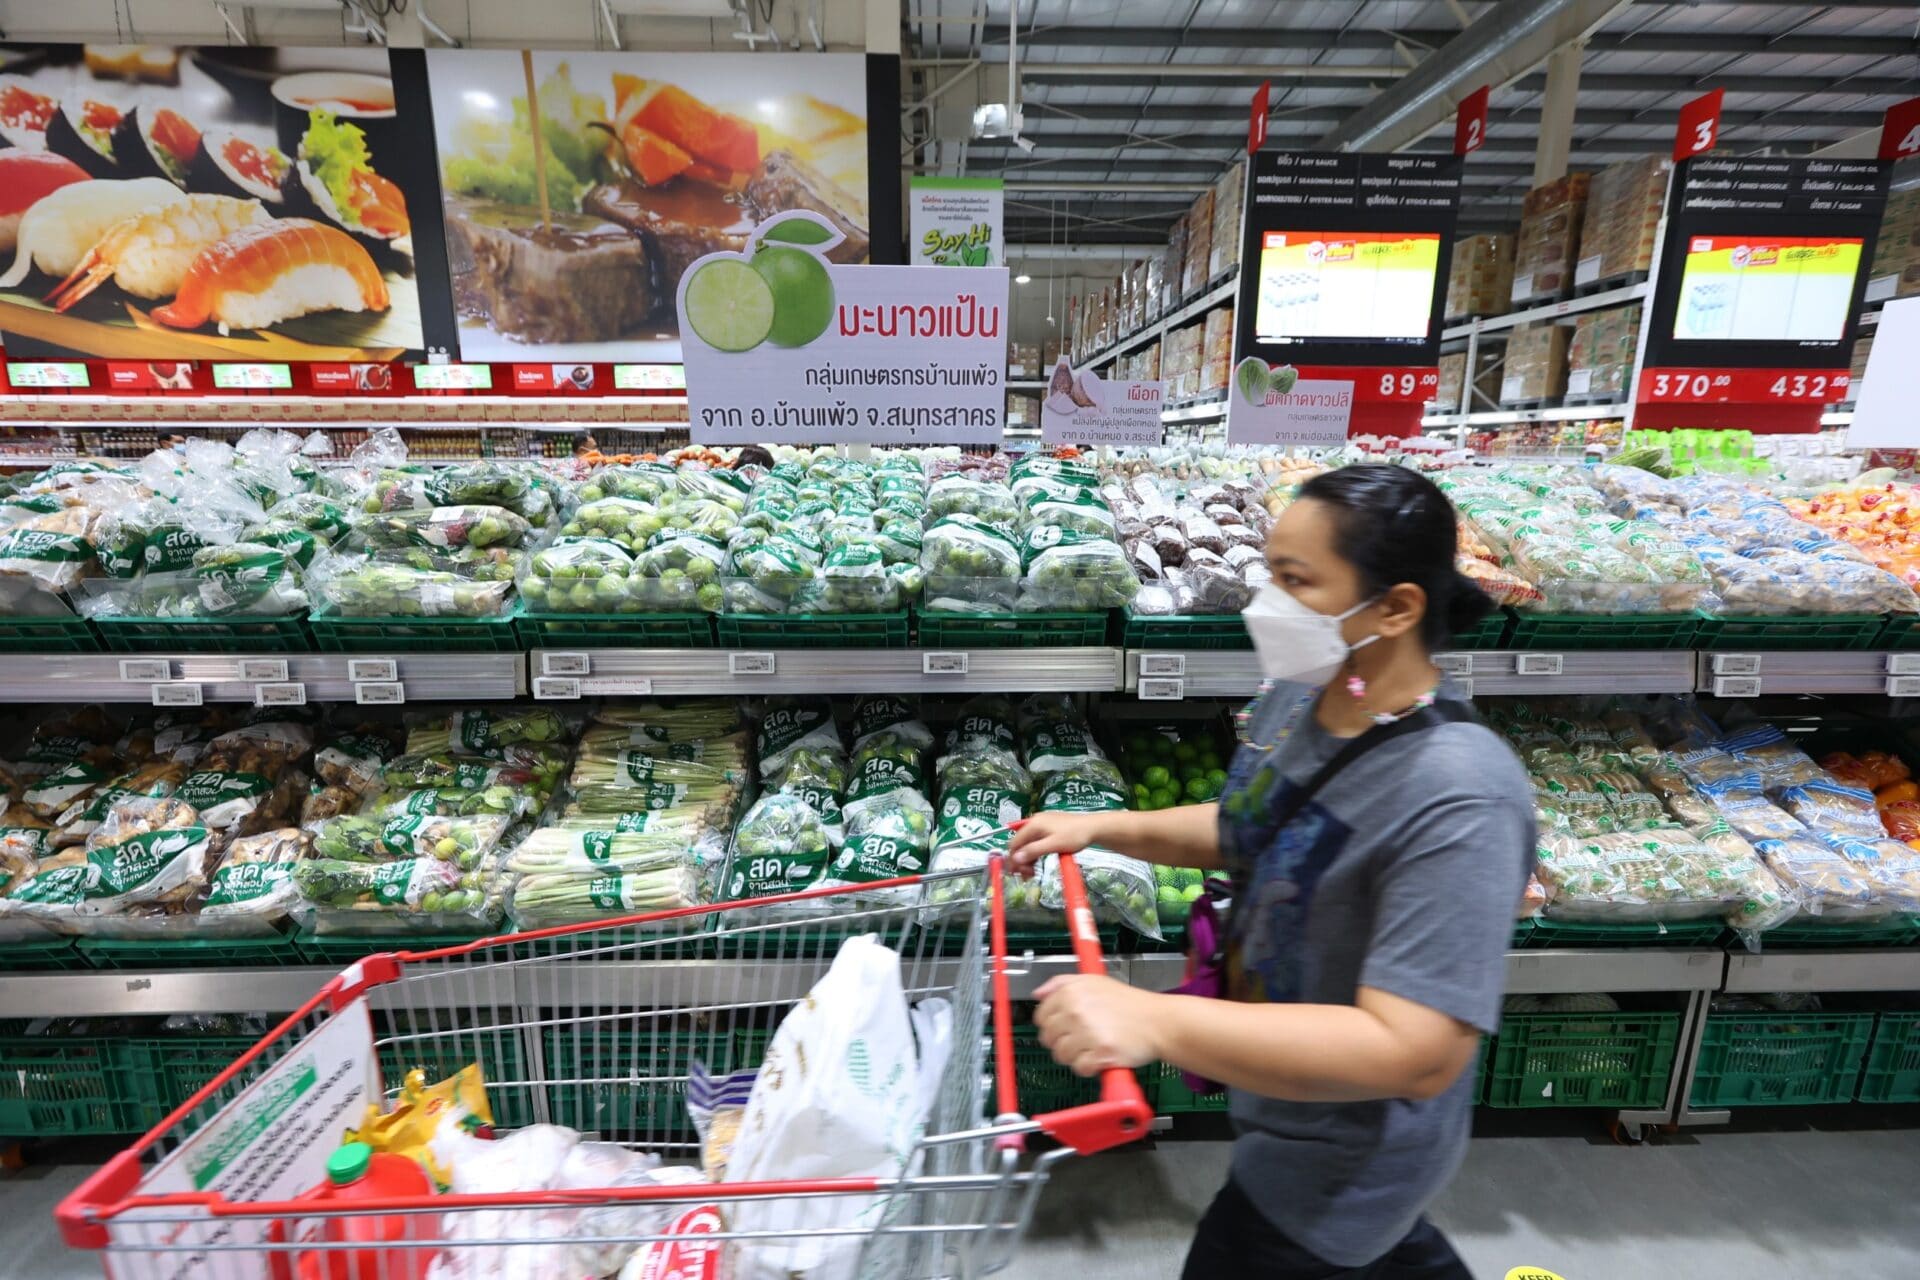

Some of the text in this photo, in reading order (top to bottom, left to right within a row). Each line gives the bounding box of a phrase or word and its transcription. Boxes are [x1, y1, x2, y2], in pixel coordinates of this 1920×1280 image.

[1257, 113, 1264, 142] 1
[1466, 118, 1481, 149] 2
[1691, 118, 1714, 151] 3
[1897, 124, 1920, 152] 4
[923, 222, 992, 256] Say Hi
[839, 294, 999, 338] มะนาวแป้น
[805, 362, 998, 392] กลุ่มเกษตรกรบ้านแพ้ว
[1127, 384, 1160, 401] เผือก
[701, 401, 997, 434] จาก อ.บ้านแพ้ว จ.สมุทรสาคร
[165, 531, 196, 547] สด
[764, 709, 791, 730] สด
[964, 717, 993, 731] สด
[865, 758, 893, 774] สด
[186, 773, 223, 786] สด
[1065, 781, 1096, 794] สด
[967, 788, 998, 803] สด
[113, 841, 147, 867] สด
[863, 837, 897, 859] สด
[46, 867, 83, 883] สด
[227, 864, 260, 881] สด
[749, 857, 782, 879] สด
